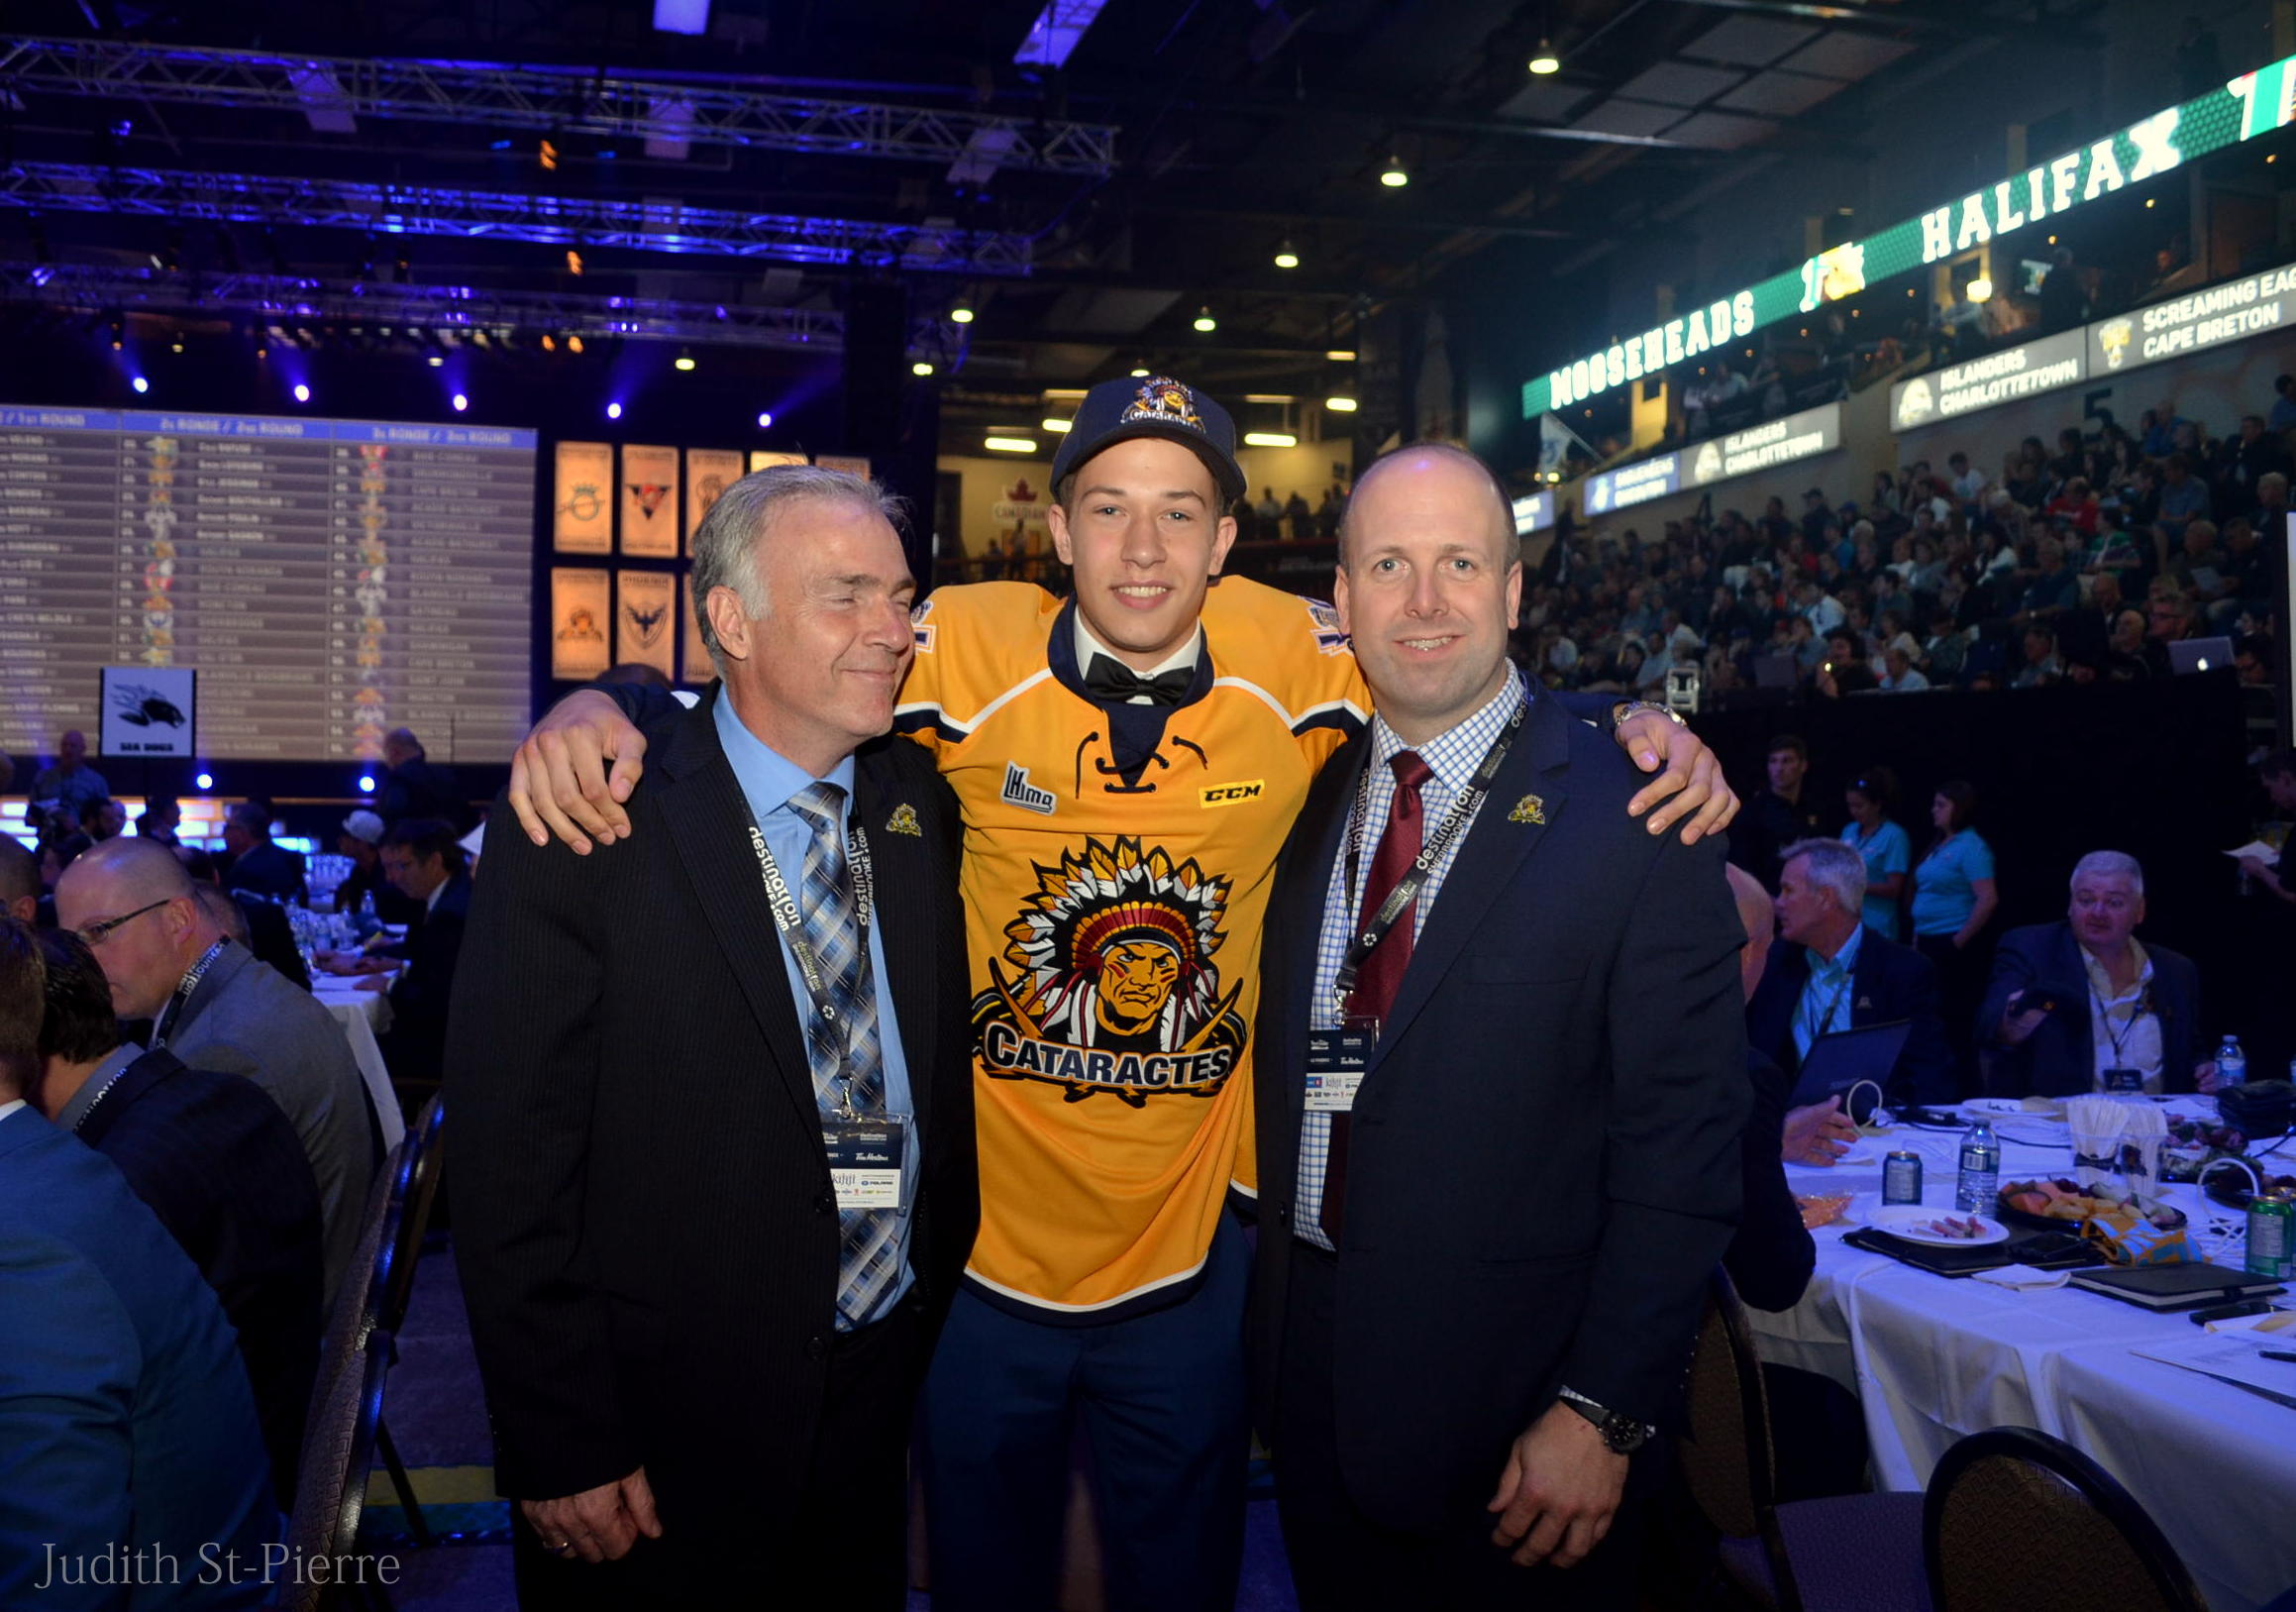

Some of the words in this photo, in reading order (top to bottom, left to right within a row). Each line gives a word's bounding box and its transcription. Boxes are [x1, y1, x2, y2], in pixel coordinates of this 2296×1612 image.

[1921, 106, 2181, 264] HALIFAX
[2142, 278, 2258, 332] SCREAMING
[2142, 326, 2194, 359] CAPE
[2197, 301, 2280, 345] BRETON
[1549, 289, 1755, 410] MOOSEHEADS
[1940, 348, 2028, 391] ISLANDERS
[1939, 358, 2079, 415] CHARLOTTETOWN
[1204, 783, 1262, 803] CCM
[1416, 785, 1475, 870] destination
[749, 825, 802, 926] destination
[987, 1021, 1232, 1087] CATARACTES
